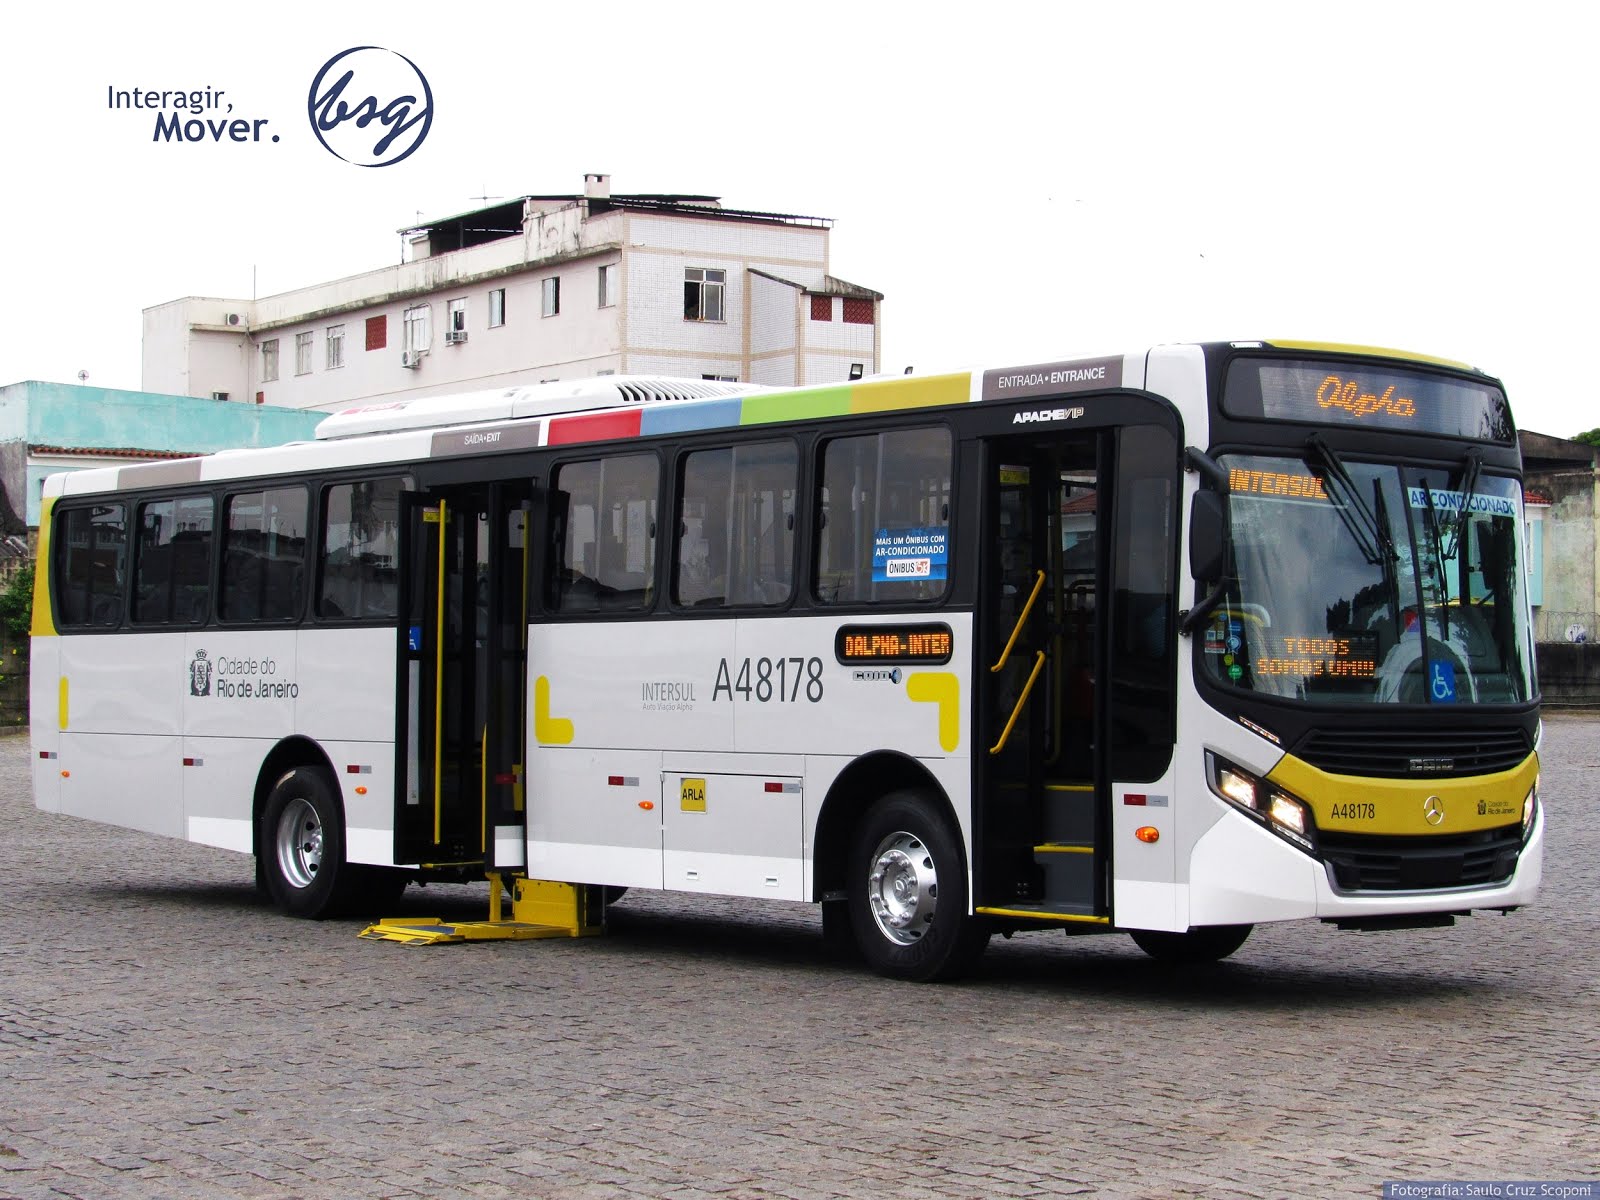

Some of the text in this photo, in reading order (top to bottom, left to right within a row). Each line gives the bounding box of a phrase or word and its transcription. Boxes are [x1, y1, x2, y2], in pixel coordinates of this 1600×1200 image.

[999, 367, 1105, 388] ENTRADA ENTRANCE
[1229, 468, 1329, 499] INTERSUL
[875, 535, 945, 546] MAIS UM ÔNIBUS COM
[875, 545, 945, 556] AR-CONDICIONADO
[1283, 637, 1350, 655] TODOS
[218, 656, 276, 675] Cidade do
[217, 679, 299, 698] Rio de Janeiro
[712, 656, 824, 703] A48178
[642, 682, 696, 702] INTERSUL
[682, 788, 704, 801] ARLA
[1331, 803, 1376, 820] A48178
